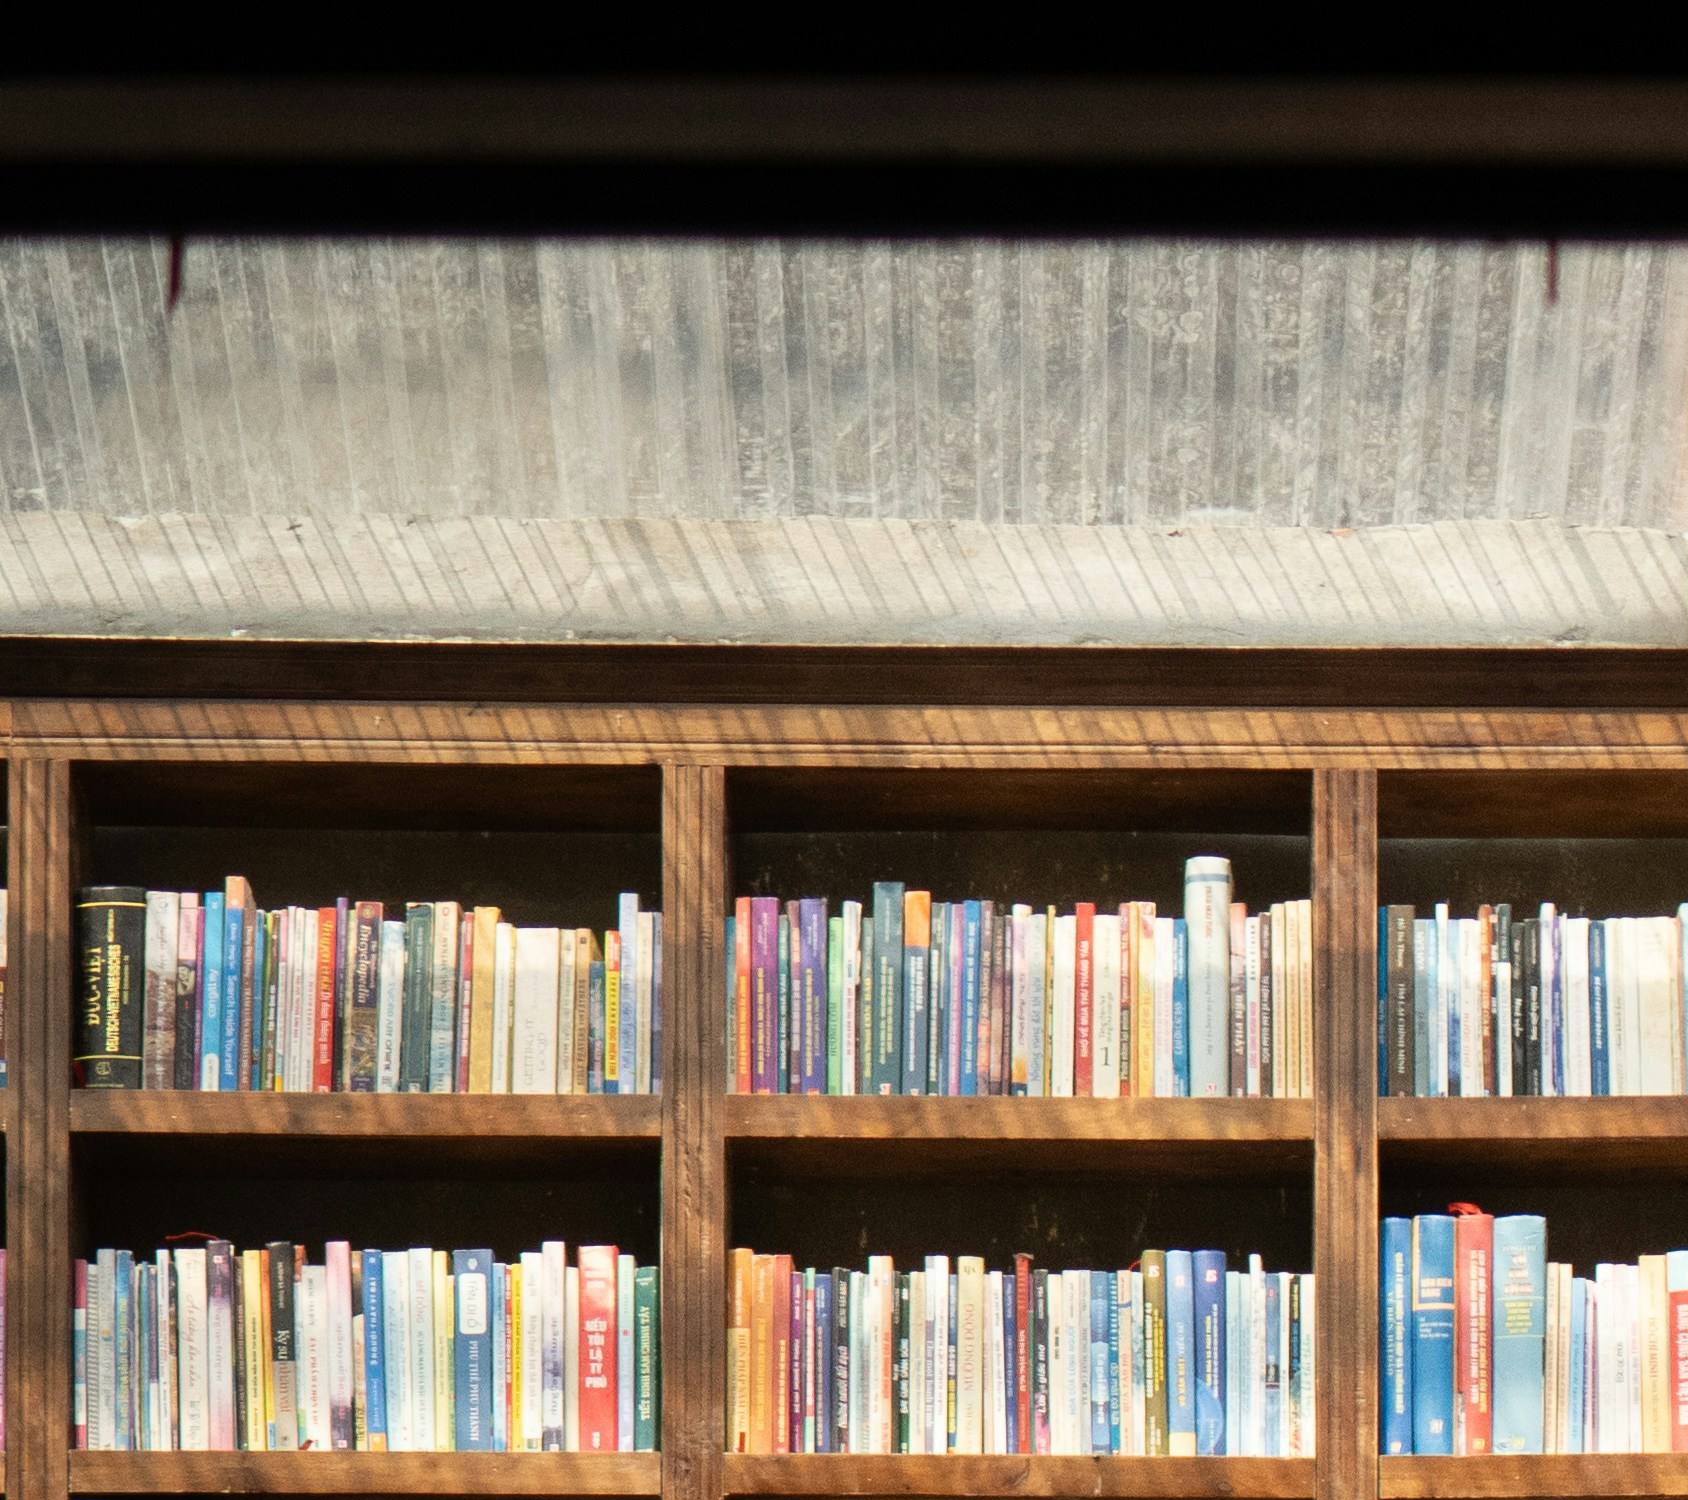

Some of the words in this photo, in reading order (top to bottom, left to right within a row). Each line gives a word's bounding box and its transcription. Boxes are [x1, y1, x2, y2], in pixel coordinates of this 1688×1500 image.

[357, 924, 373, 1003] Encyclopedia
[226, 975, 237, 1007] Search
[225, 1010, 236, 1037] Inside
[224, 1040, 235, 1076] Yourself
